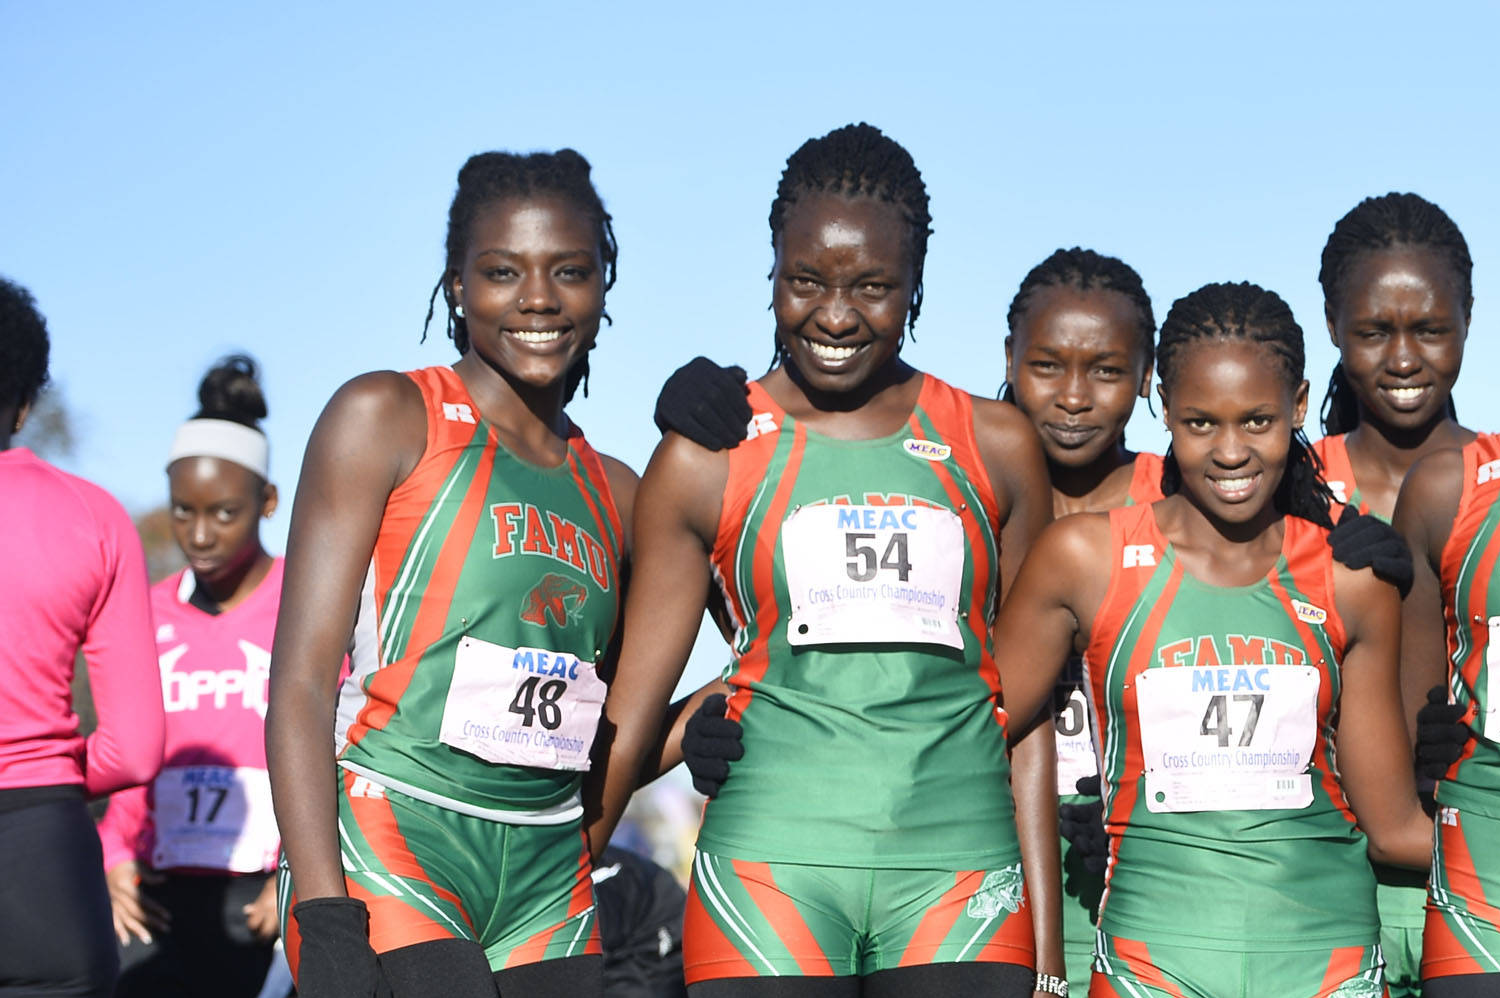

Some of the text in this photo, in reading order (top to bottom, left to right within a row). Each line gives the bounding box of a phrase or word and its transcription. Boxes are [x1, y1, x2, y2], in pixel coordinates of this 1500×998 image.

[837, 508, 917, 530] MEAC
[490, 502, 609, 592] FAMU
[845, 532, 913, 582] 54
[512, 651, 580, 681] MEAC
[1192, 668, 1270, 692] MEAC
[508, 676, 568, 730] 48
[463, 720, 490, 739] Cross
[492, 725, 533, 747] Country
[1200, 694, 1265, 747] 47
[1163, 752, 1189, 768] Cross
[186, 787, 228, 824] 17
